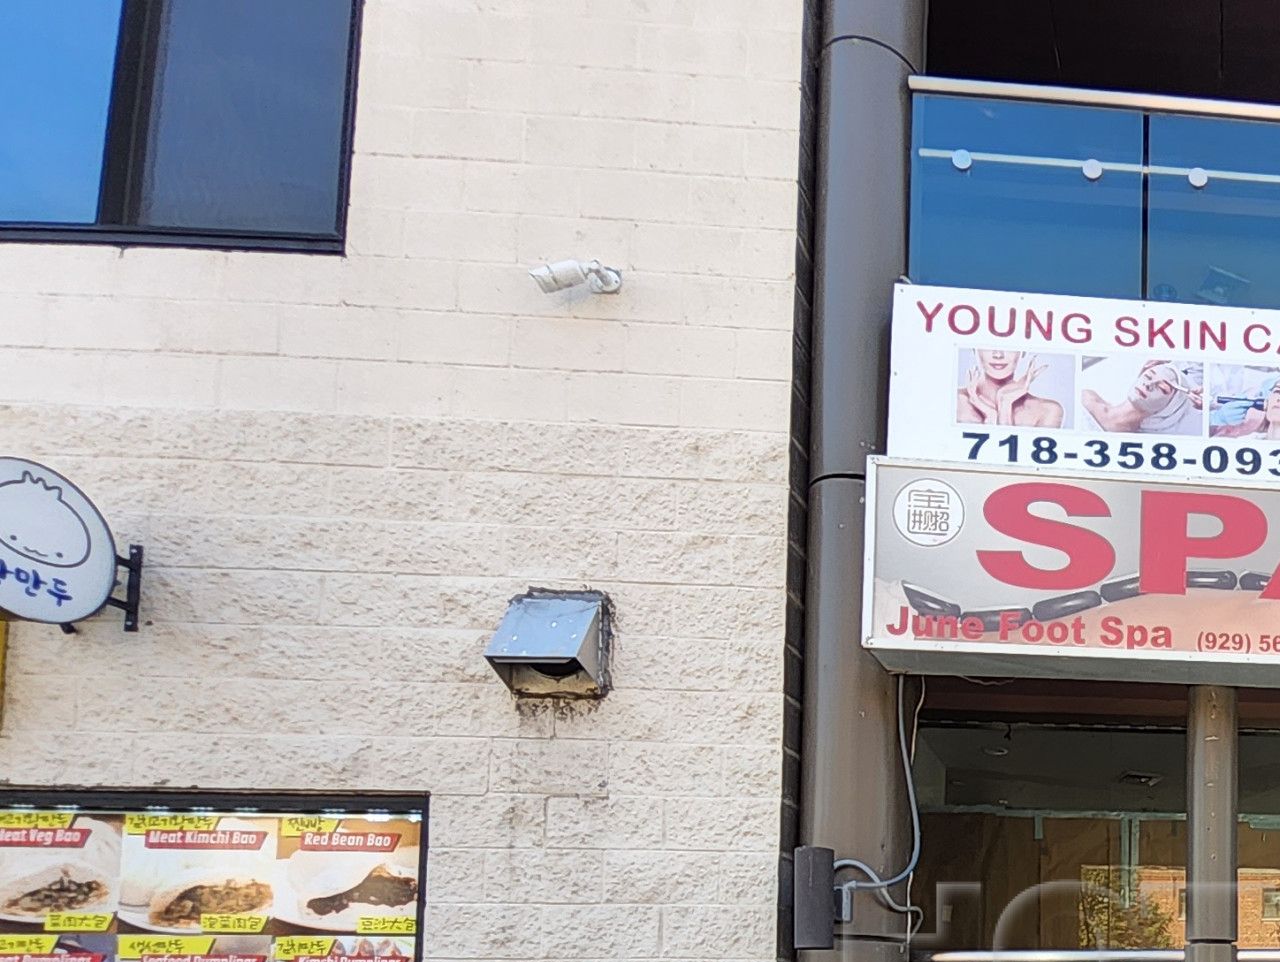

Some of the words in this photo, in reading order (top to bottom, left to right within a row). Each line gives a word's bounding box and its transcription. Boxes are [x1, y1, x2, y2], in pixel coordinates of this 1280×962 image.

[916, 300, 1094, 345] YOUNG
[1114, 315, 1229, 353] SKIN
[886, 606, 986, 642] June
[999, 609, 1087, 648] Foot
[1099, 616, 1174, 652] Spa
[1196, 631, 1253, 656] (929)
[29, 829, 54, 845] Veg
[55, 830, 81, 843] Bao
[149, 831, 183, 844] Meat
[185, 831, 230, 845] Kimchi
[231, 833, 257, 845] Bao
[304, 833, 330, 846] Red
[331, 834, 364, 847] Bean
[366, 834, 392, 848] Bao
